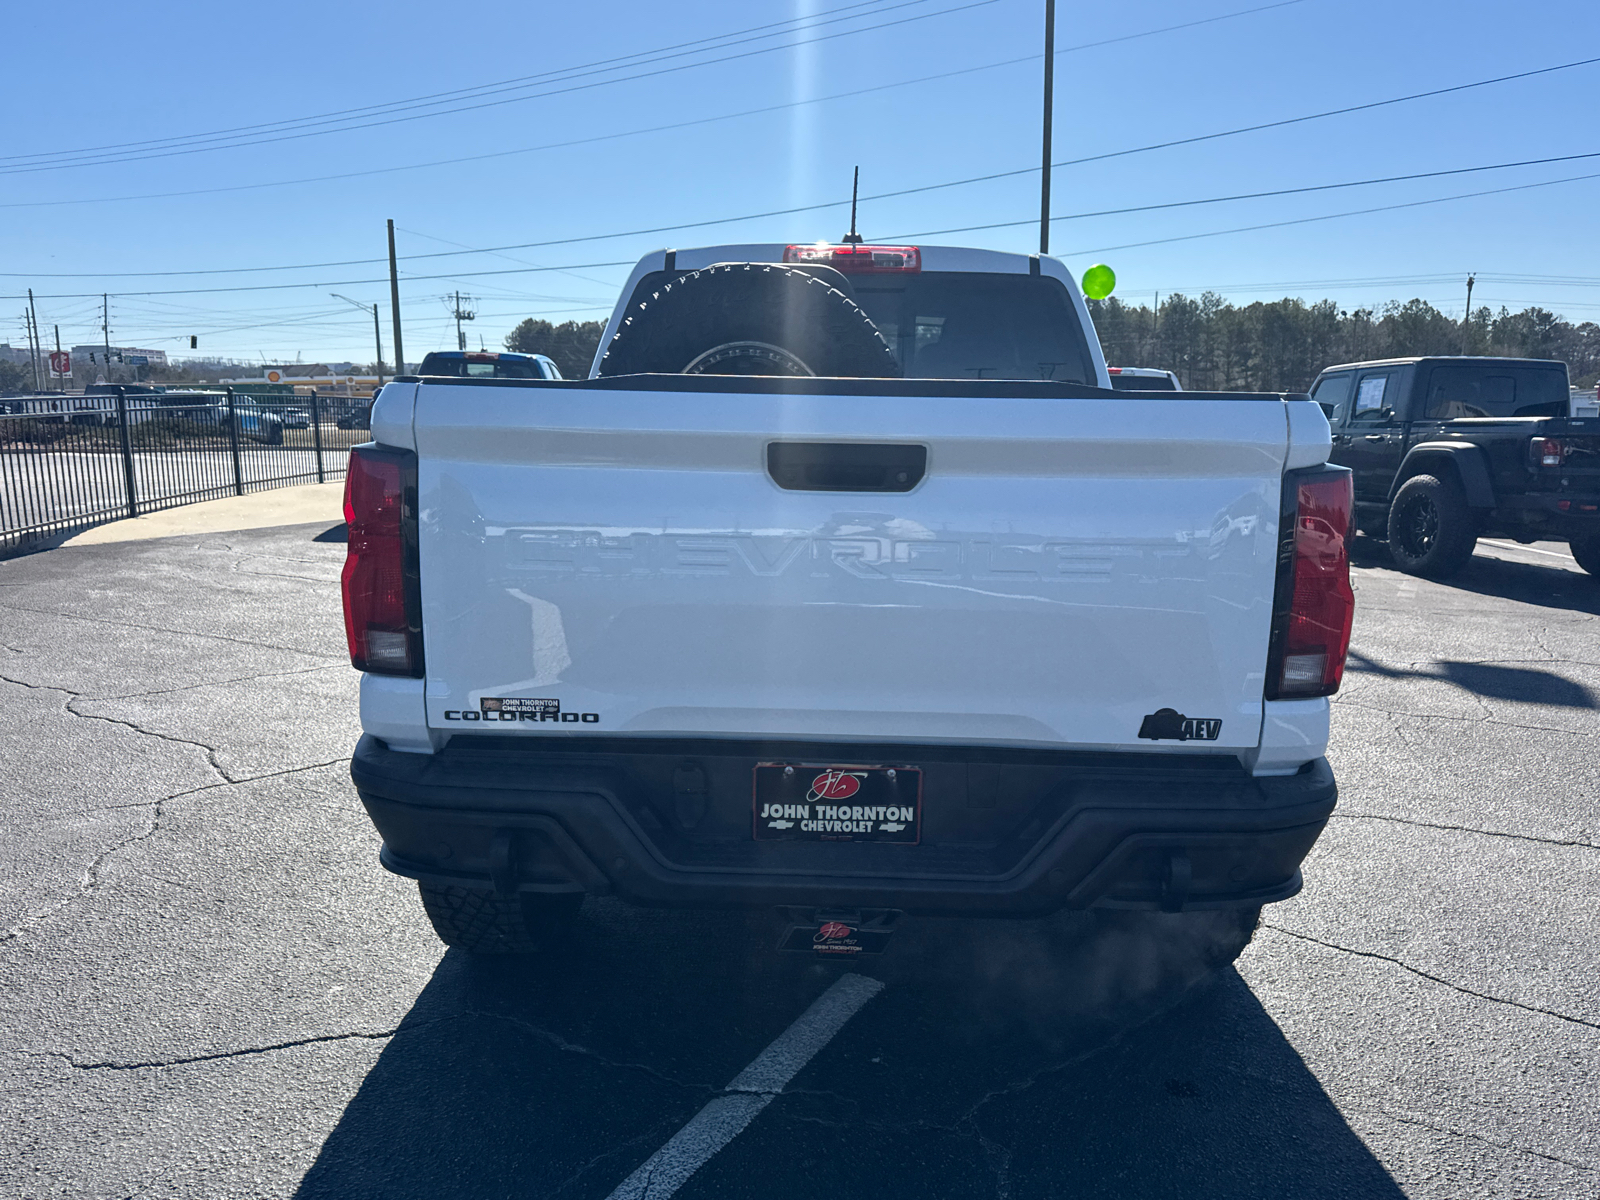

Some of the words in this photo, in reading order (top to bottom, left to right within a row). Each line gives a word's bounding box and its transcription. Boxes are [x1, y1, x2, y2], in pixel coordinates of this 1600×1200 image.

[444, 710, 600, 723] COLORADO
[1183, 720, 1219, 738] AEV
[760, 803, 810, 819] JOHN
[816, 805, 914, 821] THORNTON
[800, 820, 873, 833] CHEVROLET
